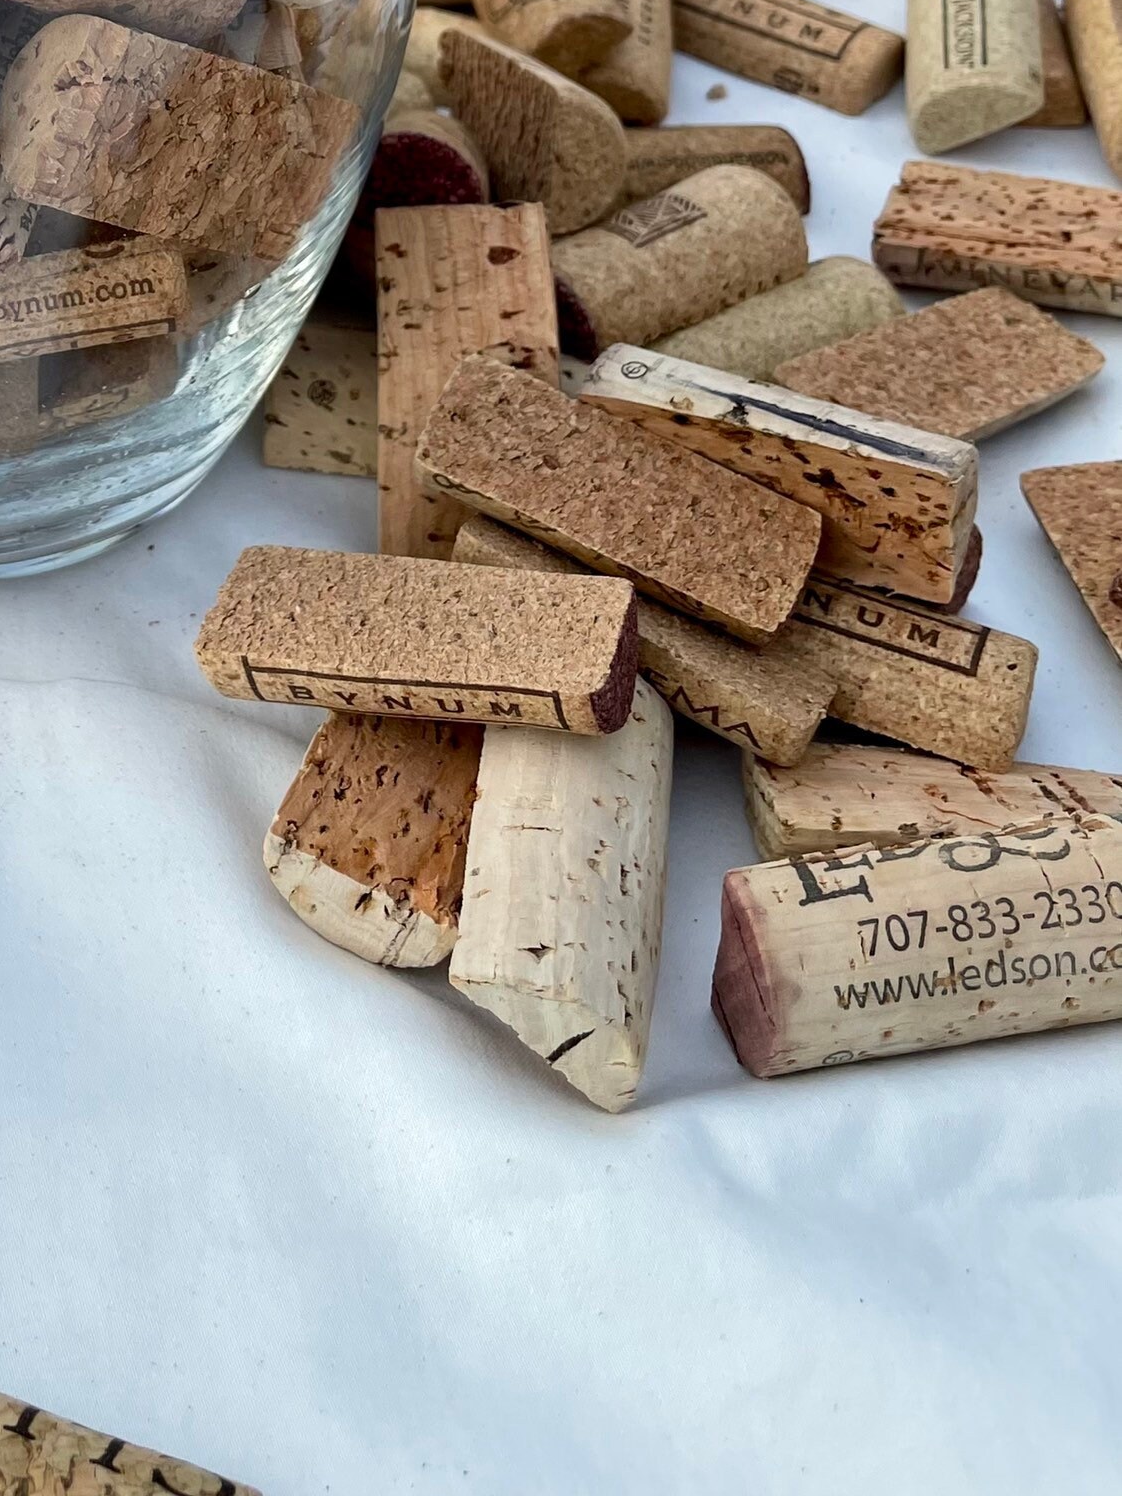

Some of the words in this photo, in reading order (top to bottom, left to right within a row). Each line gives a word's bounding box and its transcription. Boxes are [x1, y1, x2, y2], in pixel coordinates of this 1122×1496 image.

[802, 588, 941, 648] NUM
[288, 684, 523, 718] BYNUM
[641, 665, 762, 751] EMA
[857, 880, 1122, 957] 707-833-2330
